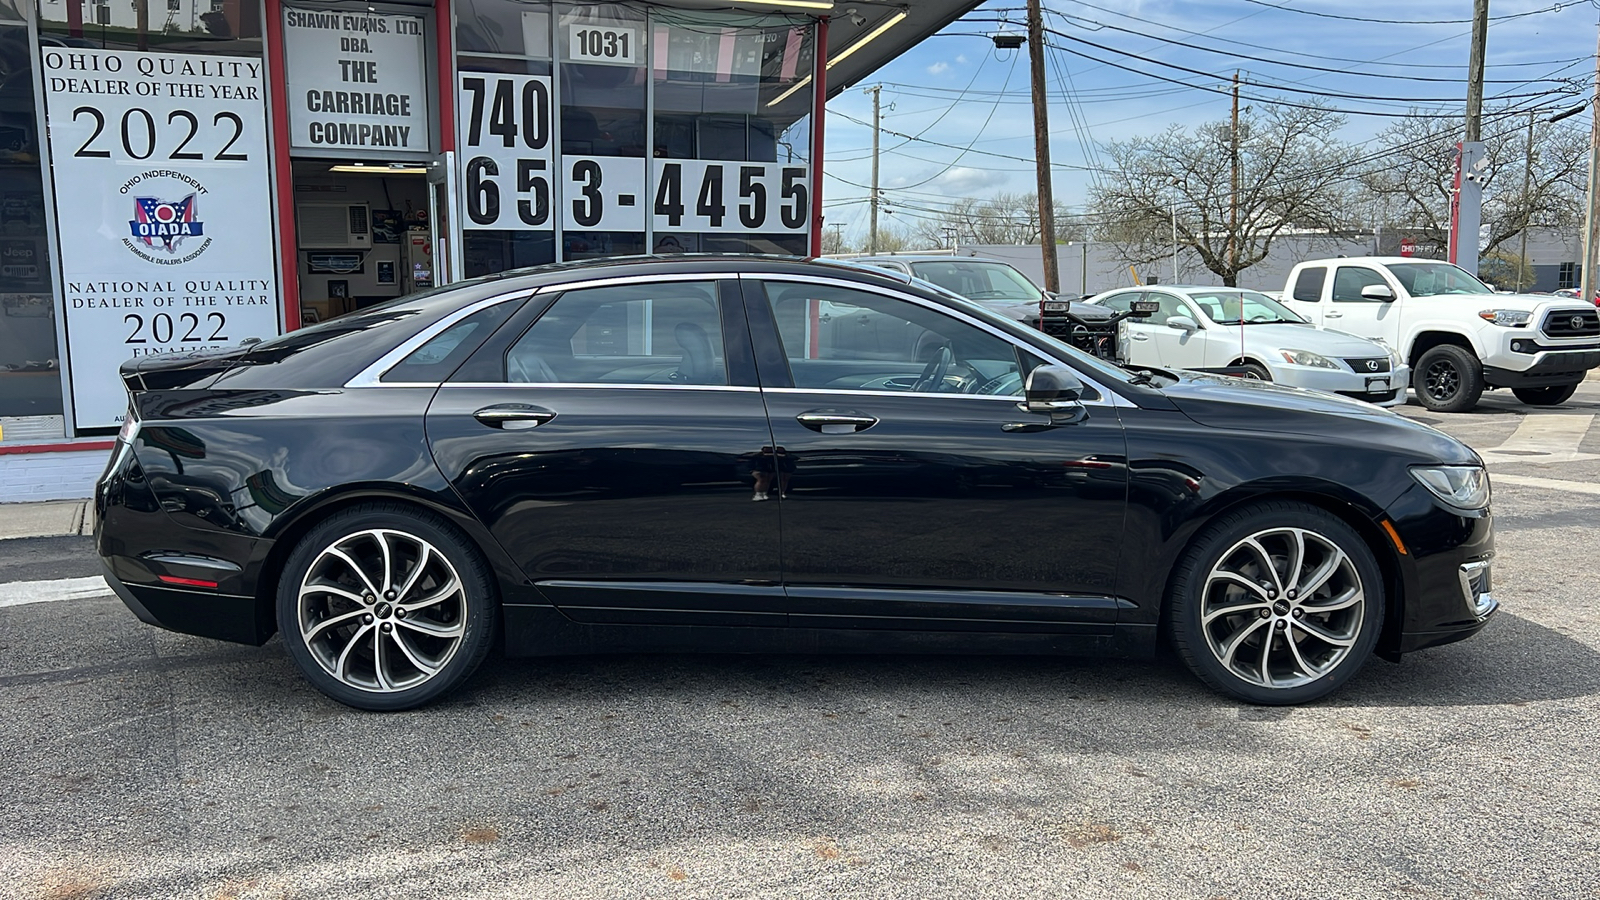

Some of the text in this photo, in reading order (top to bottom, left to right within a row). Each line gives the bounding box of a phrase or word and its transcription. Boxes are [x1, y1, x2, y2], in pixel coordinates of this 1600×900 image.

[287, 12, 422, 36] SHAWN EVANS. LTD.
[341, 37, 373, 53] DBA.
[577, 29, 629, 59] 1031
[46, 53, 259, 79] OHIO QUALITY
[338, 60, 378, 83] THE
[51, 78, 259, 100] DEALER OF THE YEAR
[307, 90, 411, 116] CARRIAGE
[462, 77, 549, 150] 740
[72, 106, 249, 161] 2022
[309, 122, 411, 147] COMPANY
[120, 170, 209, 195] OHIO INDEPENDENT
[139, 223, 192, 236] OIADA
[3, 247, 33, 258] Jeep
[121, 237, 213, 266] AUTOMOBILE DEALERS ASSOCIATION
[1401, 245, 1415, 253] OHIO
[68, 280, 270, 294] NATIONAL QUALITY
[73, 295, 269, 309] DEALER OF THE YEAR
[124, 311, 229, 345] 2022
[132, 345, 220, 358] FINA
